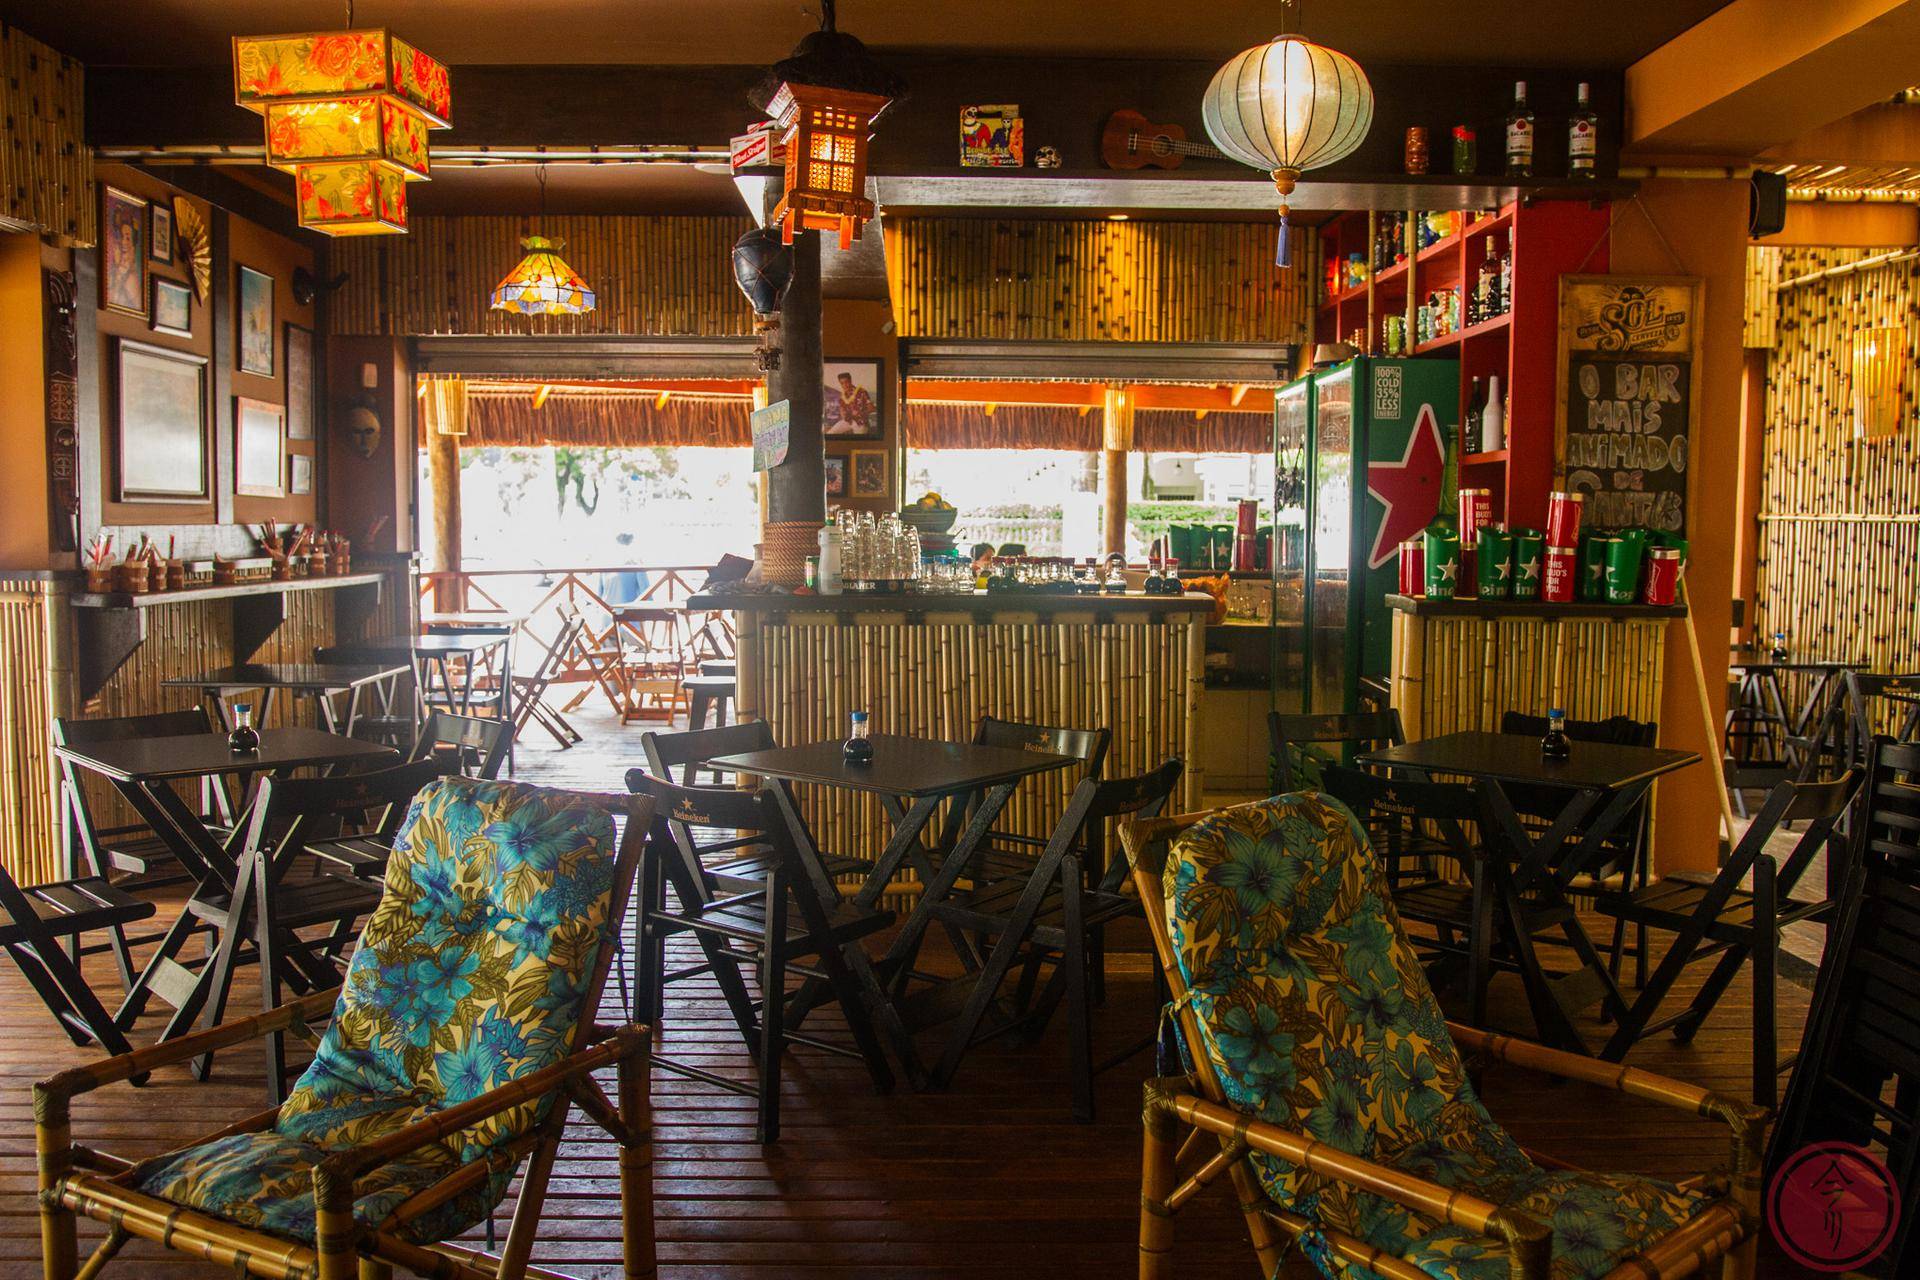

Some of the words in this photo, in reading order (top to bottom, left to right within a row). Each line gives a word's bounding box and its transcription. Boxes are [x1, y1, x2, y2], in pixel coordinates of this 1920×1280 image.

[1376, 368, 1400, 378] 100%
[1377, 378, 1399, 387] COLD
[1578, 364, 1600, 399] O
[1615, 363, 1681, 403] BAR
[1376, 388, 1399, 398] 35%
[1377, 399, 1398, 410] LESS
[1475, 502, 1490, 510] THIS
[672, 807, 710, 824] Heineken
